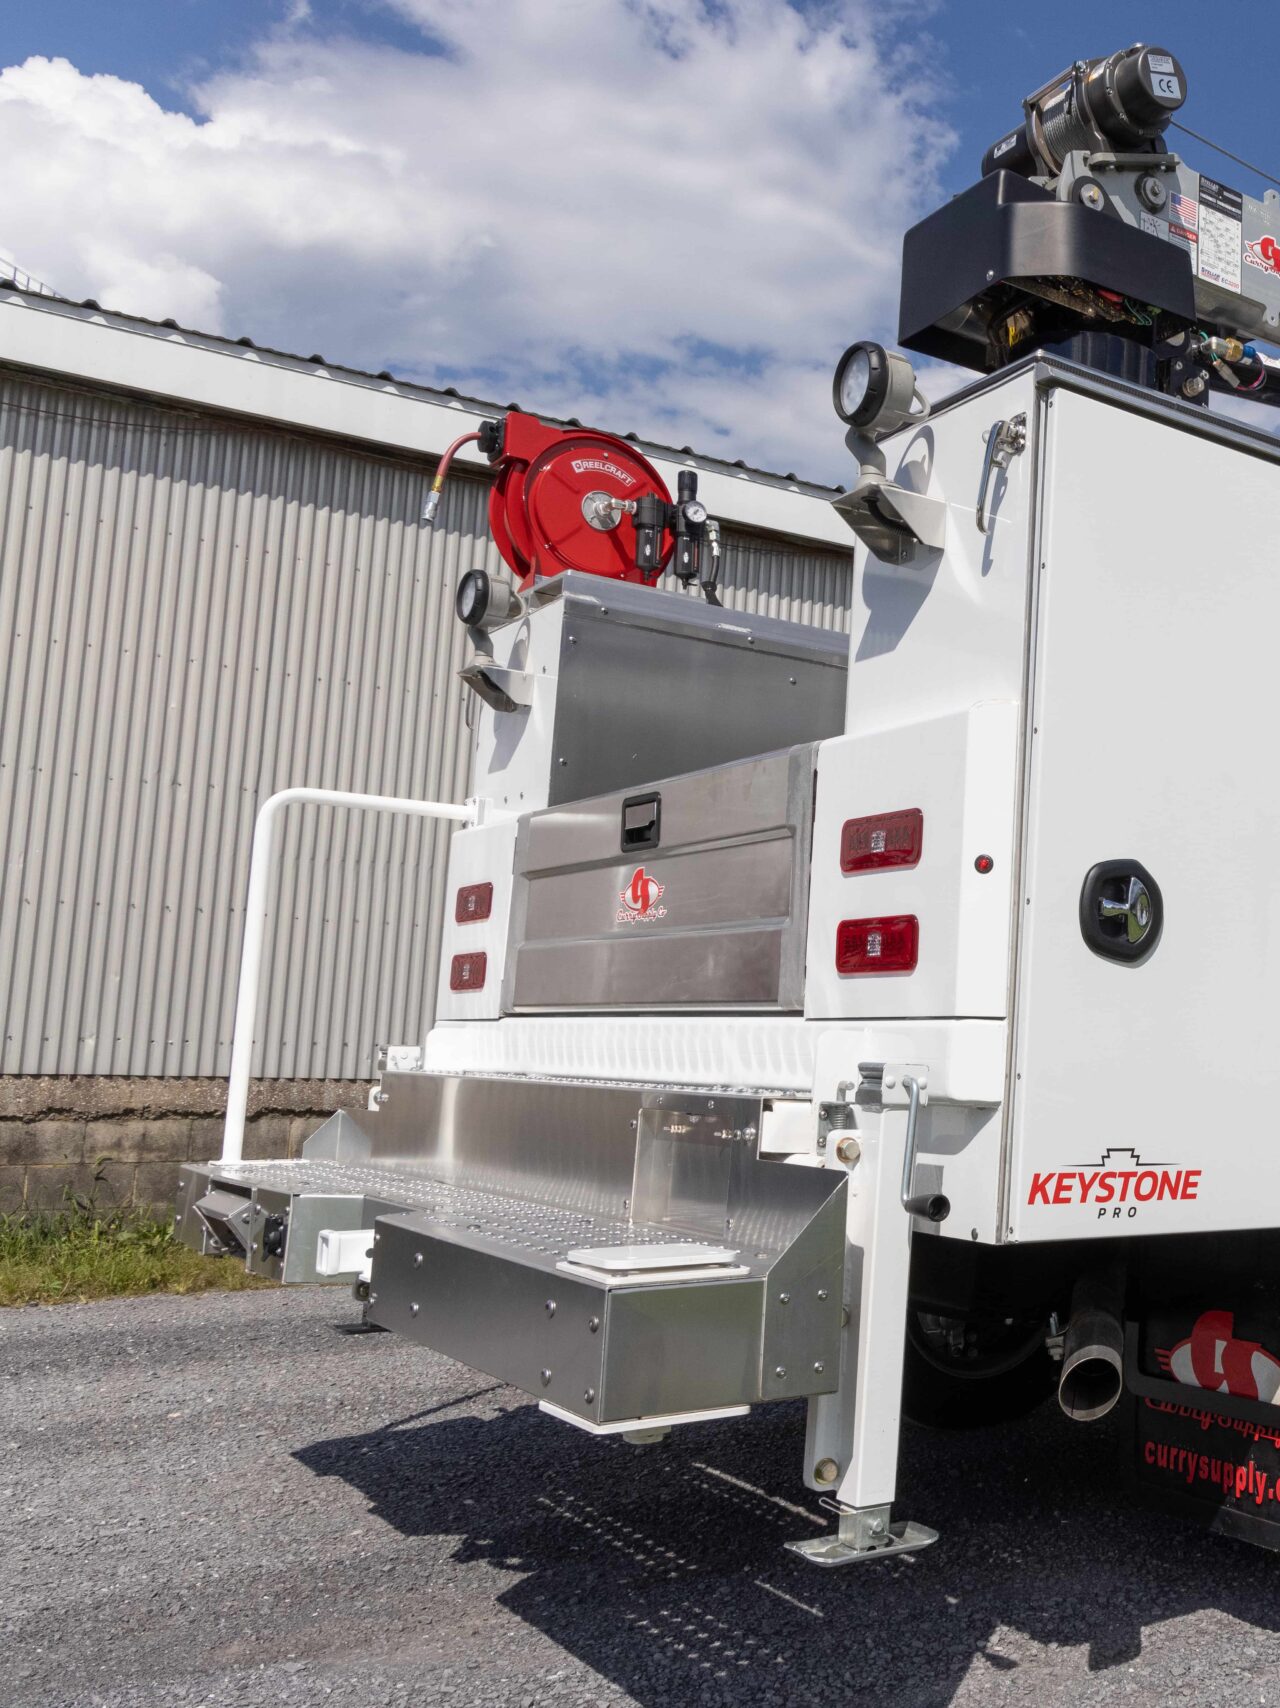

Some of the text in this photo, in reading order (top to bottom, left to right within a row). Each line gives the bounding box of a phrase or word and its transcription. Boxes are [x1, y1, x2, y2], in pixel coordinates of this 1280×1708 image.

[1159, 79, 1174, 94] CE
[1244, 254, 1269, 273] Curry
[582, 461, 634, 485] REELCRAFT
[1027, 1169, 1202, 1206] KEYSTONE
[1097, 1206, 1138, 1220] PRO
